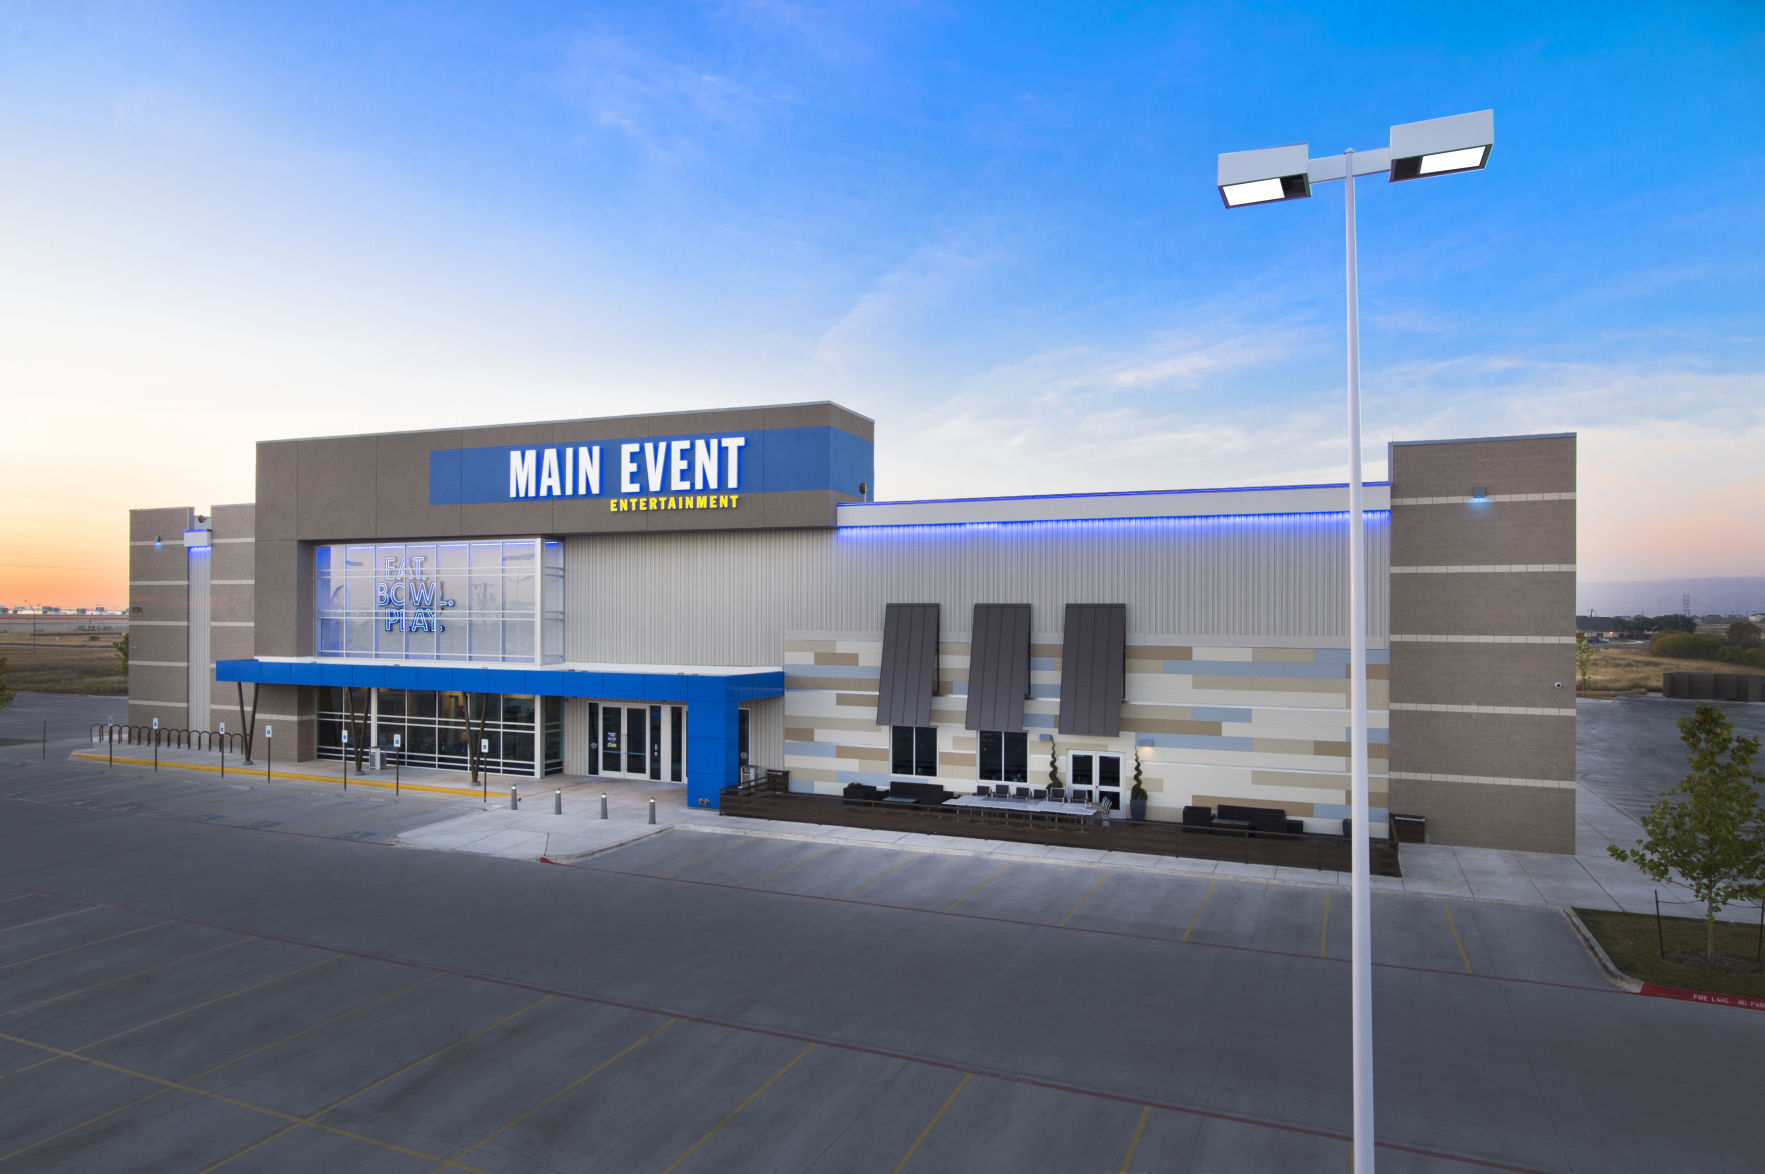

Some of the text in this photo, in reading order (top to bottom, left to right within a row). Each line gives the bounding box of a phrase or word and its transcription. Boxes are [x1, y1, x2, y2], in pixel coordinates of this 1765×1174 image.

[509, 437, 745, 498] MAIN EVENT
[610, 495, 739, 512] ENTERTAINMENT
[384, 556, 427, 580] EAT.
[1693, 994, 1708, 1002] FIRE
[1711, 996, 1729, 1004] LANE
[1750, 1001, 1765, 1009] PAR
